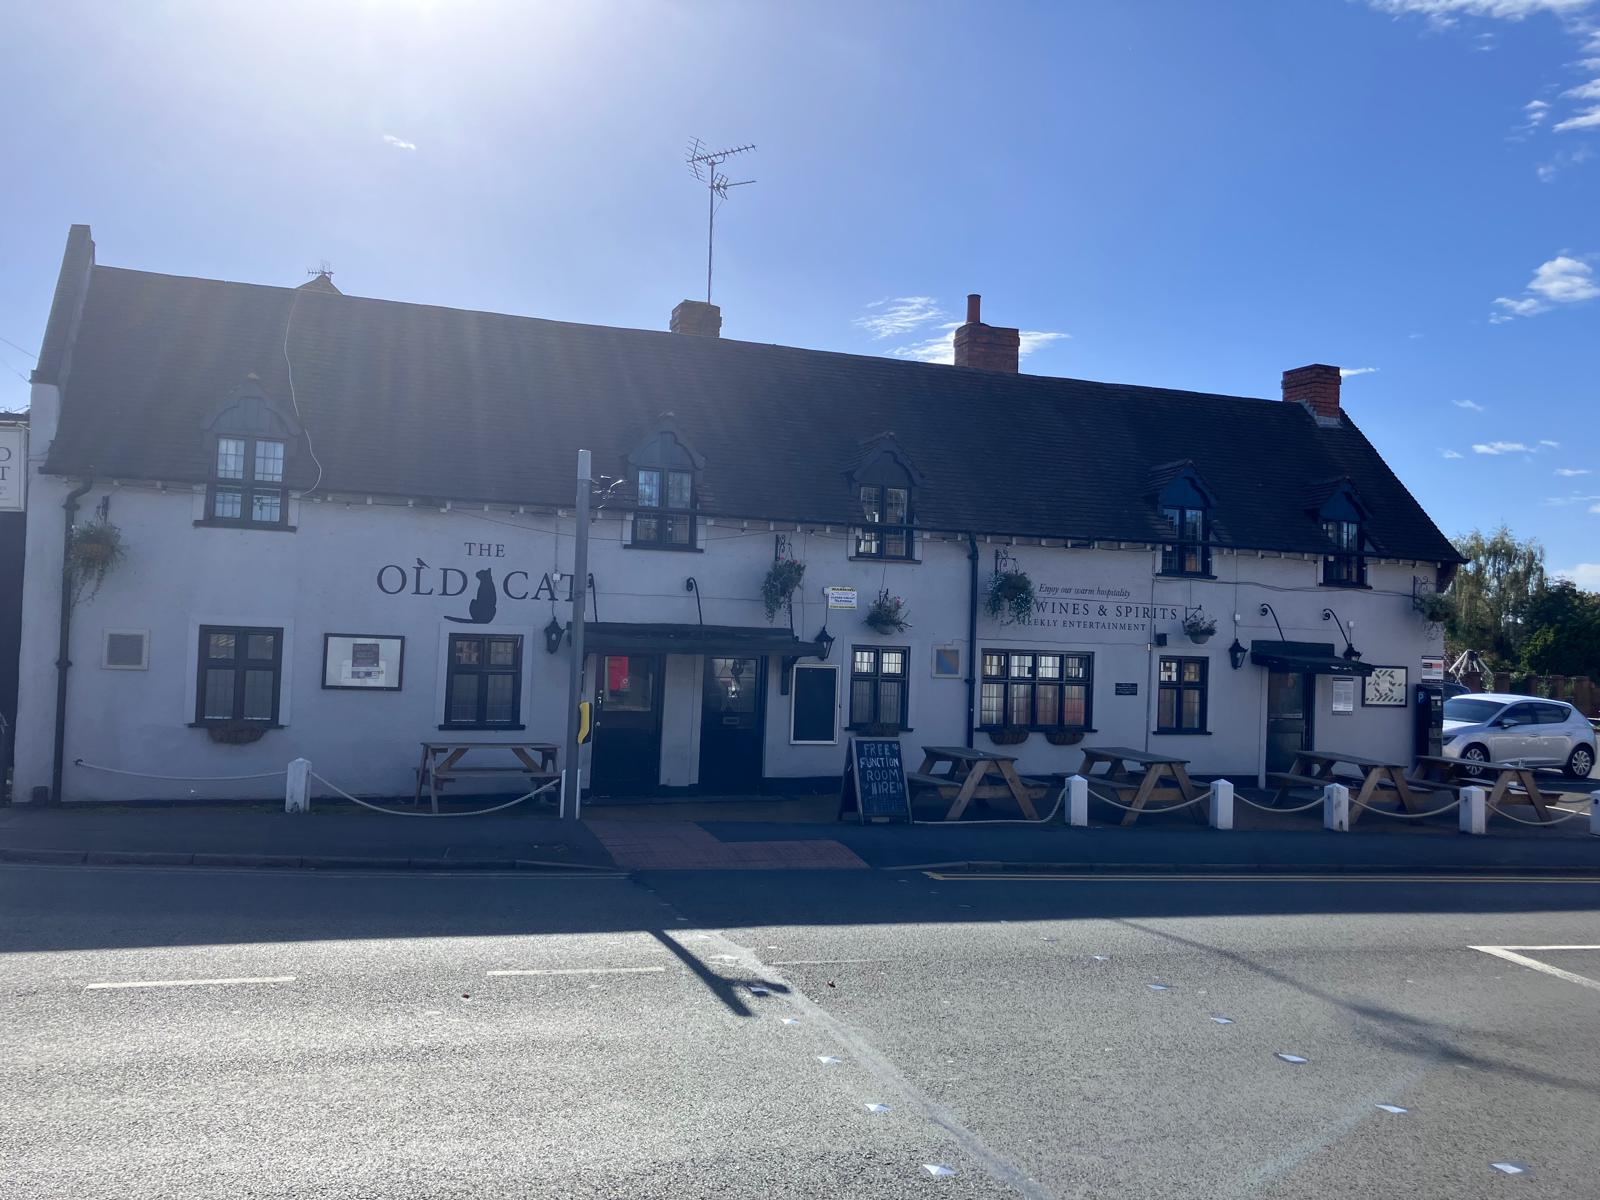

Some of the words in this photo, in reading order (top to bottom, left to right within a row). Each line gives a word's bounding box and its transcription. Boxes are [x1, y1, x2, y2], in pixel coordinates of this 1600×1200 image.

[463, 541, 506, 558] THE
[376, 564, 469, 597] OLD
[1038, 583, 1059, 595] Enjoy
[1061, 586, 1073, 594] our
[1074, 587, 1095, 596] warm
[1096, 587, 1131, 600] hospitality
[1034, 601, 1090, 616] WINES
[1097, 604, 1108, 617] &
[1115, 605, 1178, 621] SPIRITS
[1062, 619, 1147, 632] ENTERTAINMENT
[859, 756, 899, 768] FUNCTION
[866, 769, 899, 781] ROOM
